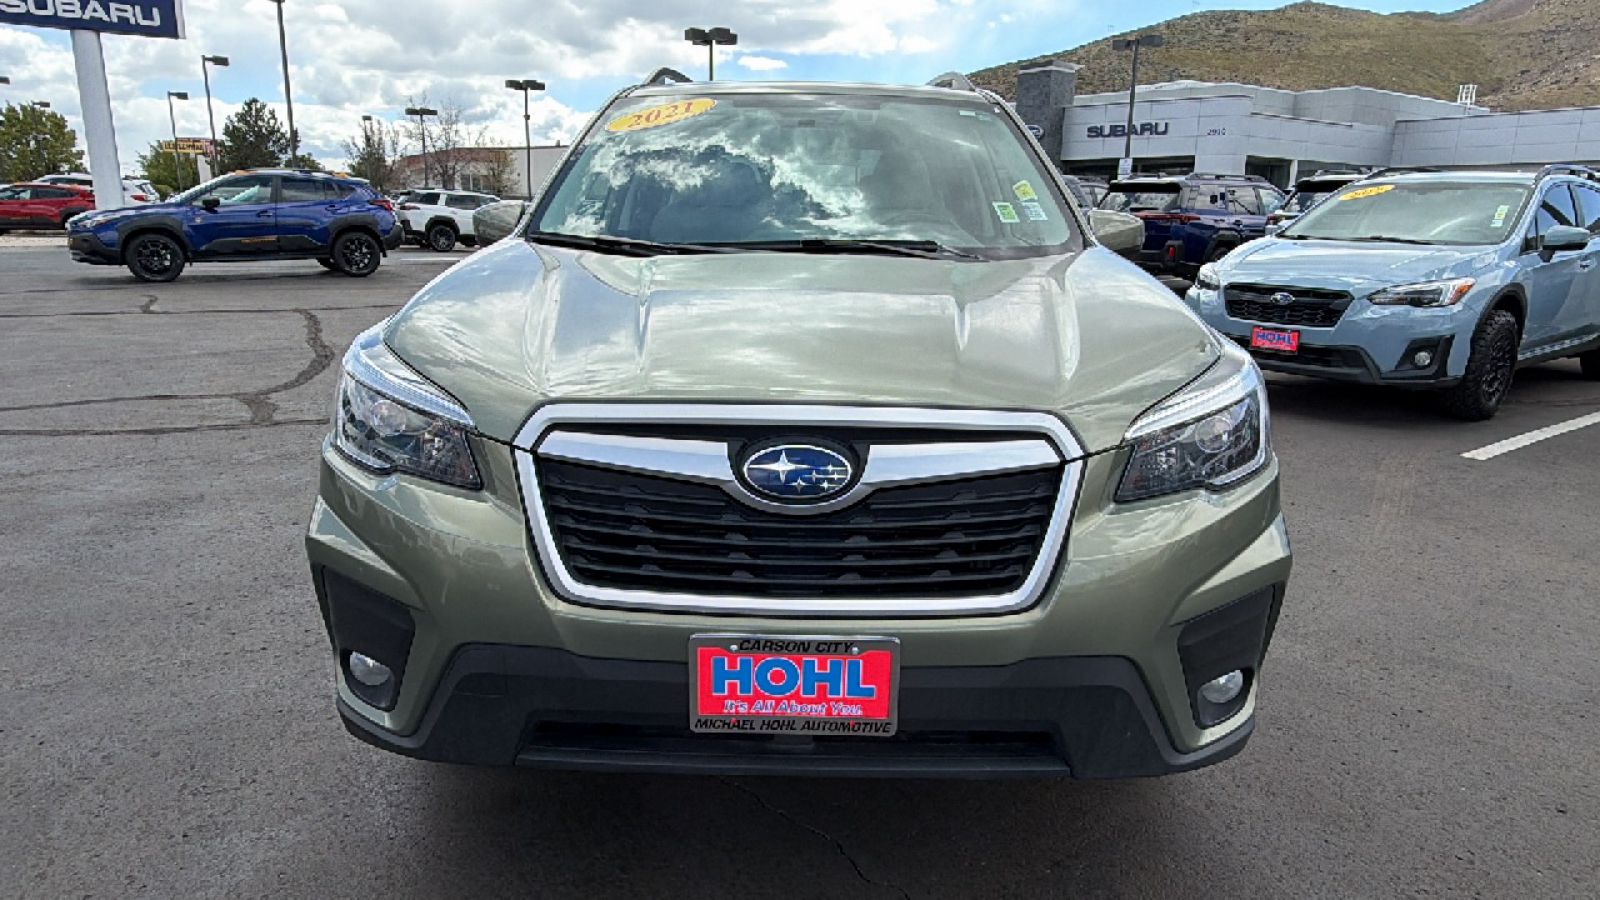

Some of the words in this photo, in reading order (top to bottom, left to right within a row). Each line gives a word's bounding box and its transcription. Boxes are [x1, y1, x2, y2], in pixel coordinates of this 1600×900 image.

[627, 101, 694, 128] 2021
[1086, 122, 1169, 138] SUBARU
[1255, 330, 1293, 345] HOHL
[739, 639, 811, 653] CARSON
[814, 641, 855, 653] CITY
[711, 656, 876, 698] HOHL
[723, 700, 748, 712] It's
[752, 700, 775, 713] All
[777, 700, 827, 714] About
[694, 718, 756, 731] MICHAEL
[759, 719, 798, 731] HOHL
[800, 720, 892, 733] AUTOMOTIVE
